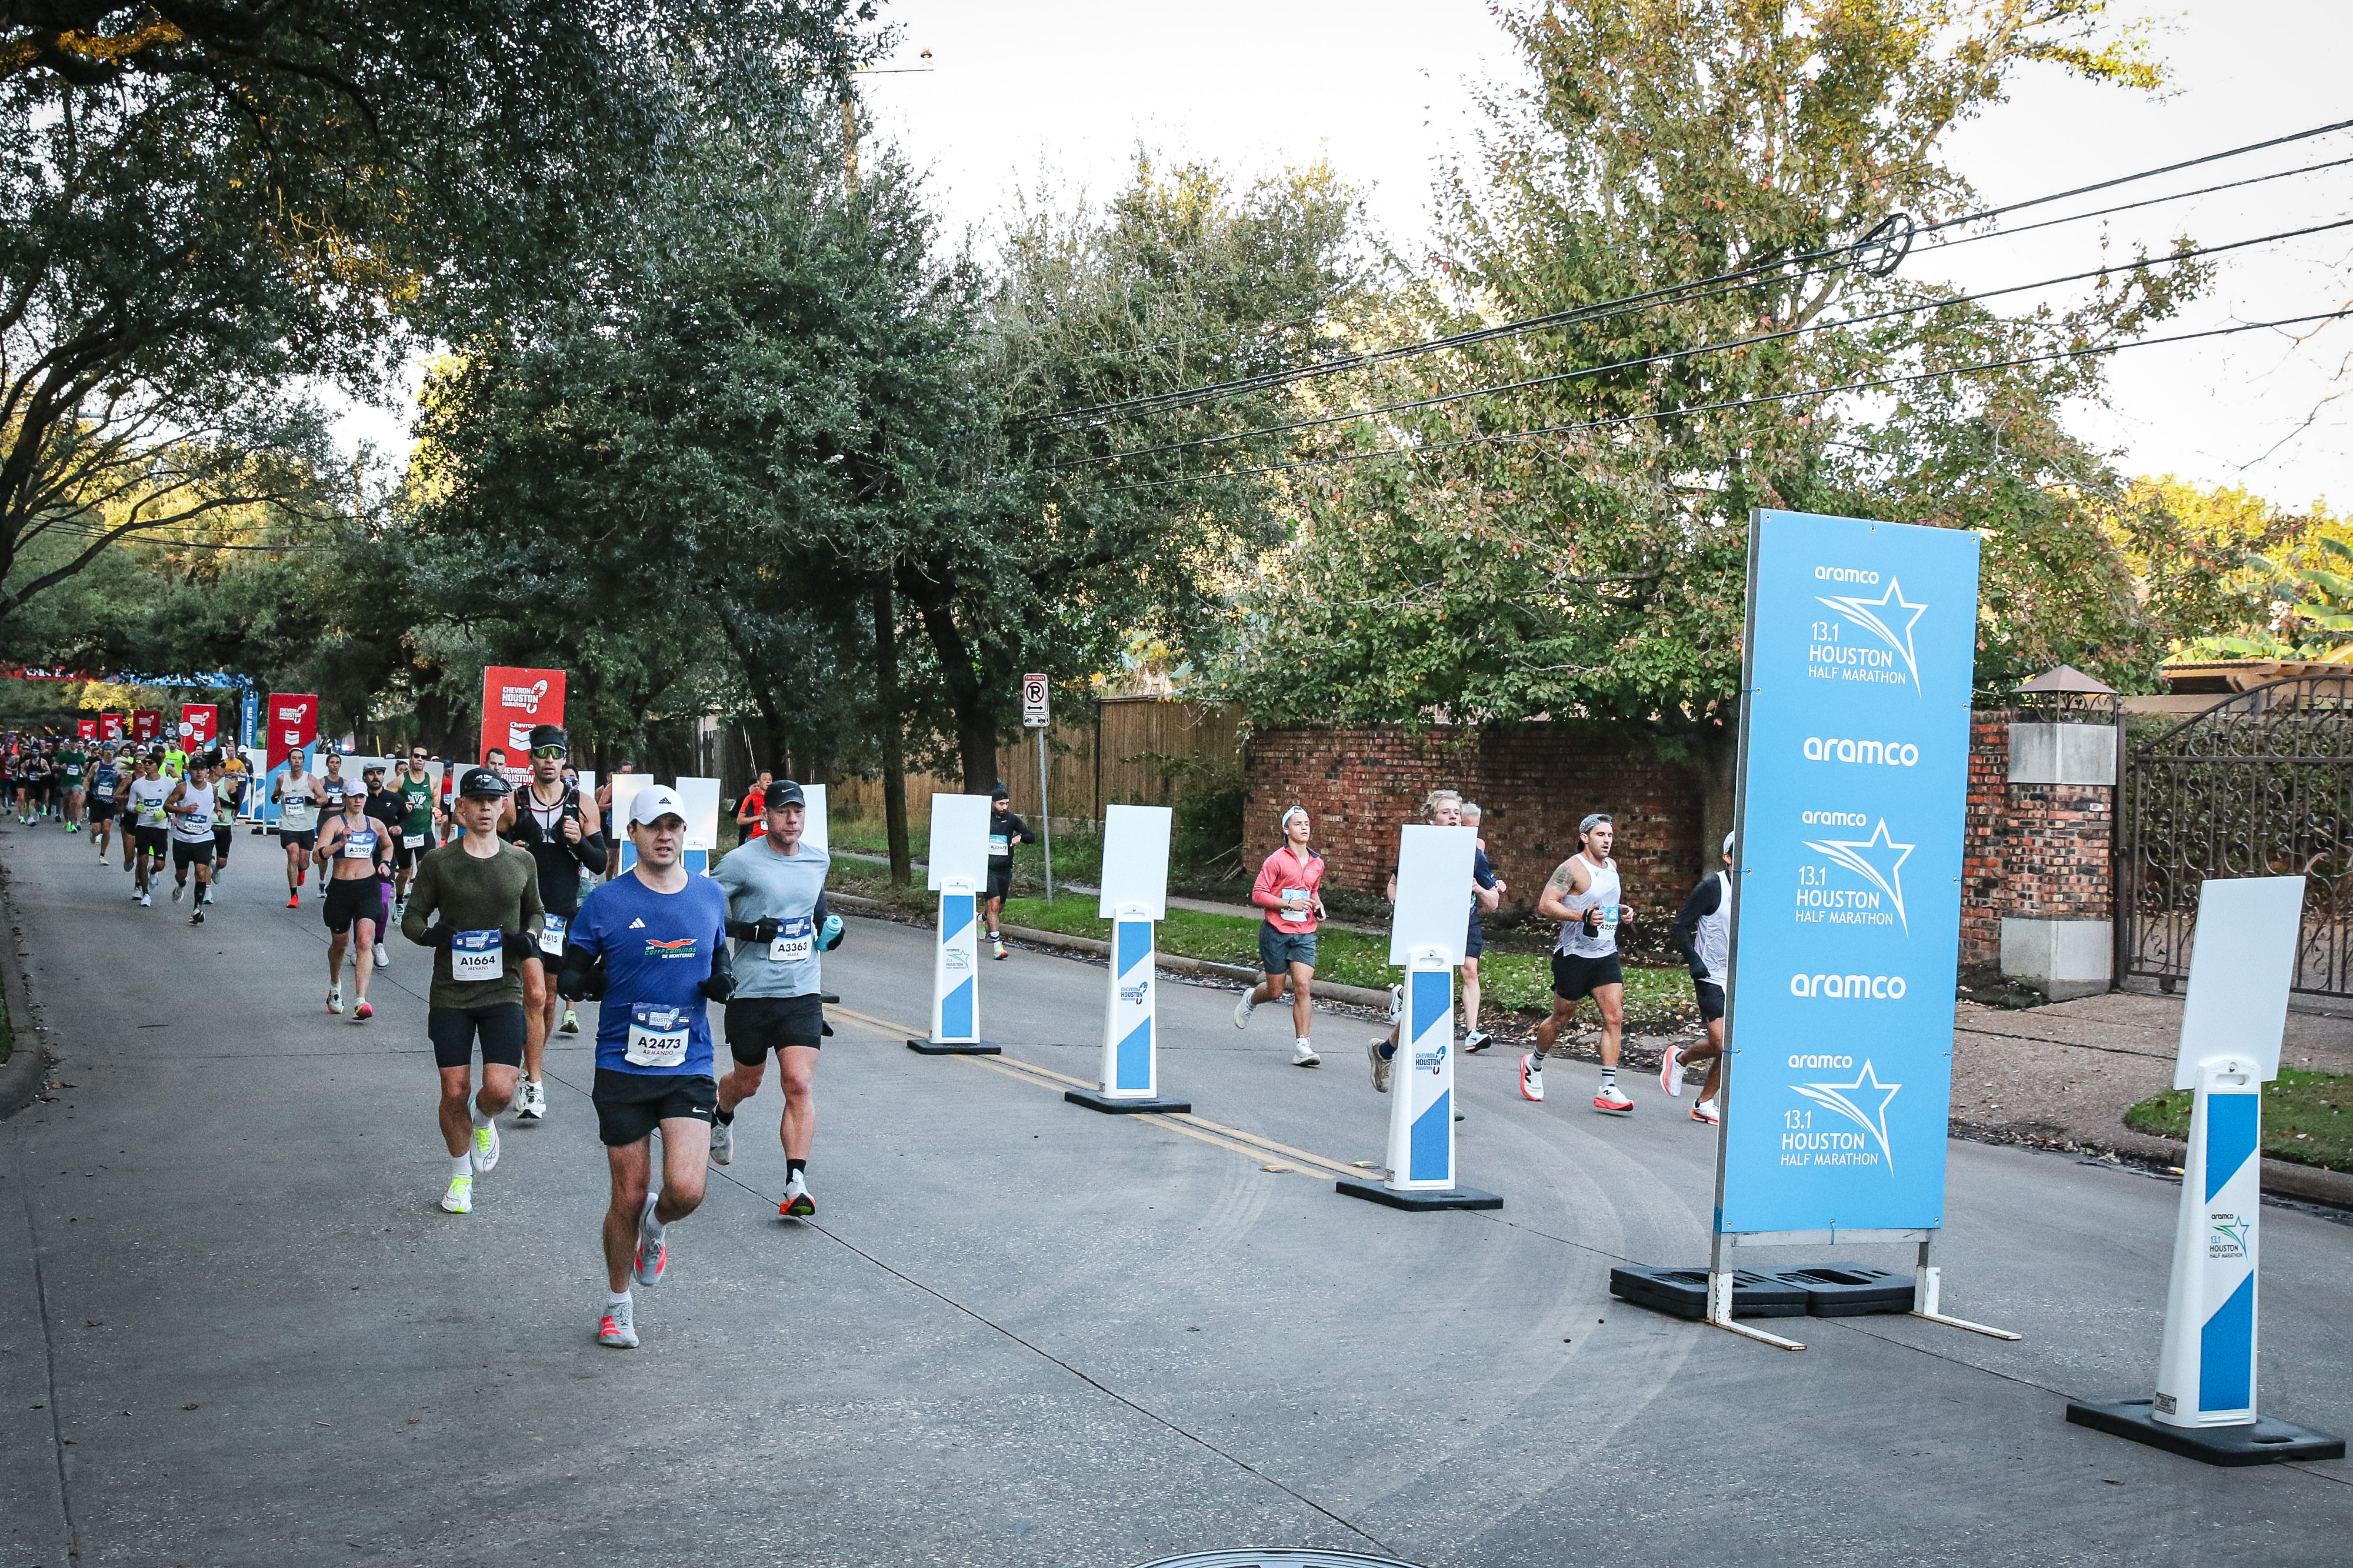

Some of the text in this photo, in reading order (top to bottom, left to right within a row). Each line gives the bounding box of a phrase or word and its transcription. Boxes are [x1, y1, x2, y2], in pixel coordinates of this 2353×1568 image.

[1814, 566, 1879, 585] aramco
[1811, 621, 1839, 642] 13.1
[1808, 644, 1892, 668] HOUSTON
[1808, 665, 1906, 685] HALF MARATHON
[502, 686, 531, 695] CHEVRON
[502, 693, 539, 703] HOUSTON
[509, 721, 536, 729] Chevron
[1802, 736, 1919, 767] aramco
[1801, 810, 1867, 827] aramco
[1798, 865, 1827, 885] 13.1
[1795, 889, 1880, 910] HOUSTON
[1795, 910, 1894, 926] HALF MARATHON
[542, 933, 558, 943] 1615
[778, 942, 807, 952] A3363
[460, 955, 496, 966] A1664
[1790, 973, 1907, 999] aramco
[638, 1036, 681, 1049] A2473
[1788, 1055, 1852, 1069] aramco
[1783, 1109, 1812, 1129] 13.1
[1781, 1132, 1865, 1150] HOUSTON
[1780, 1153, 1878, 1166] HALF MARATHON
